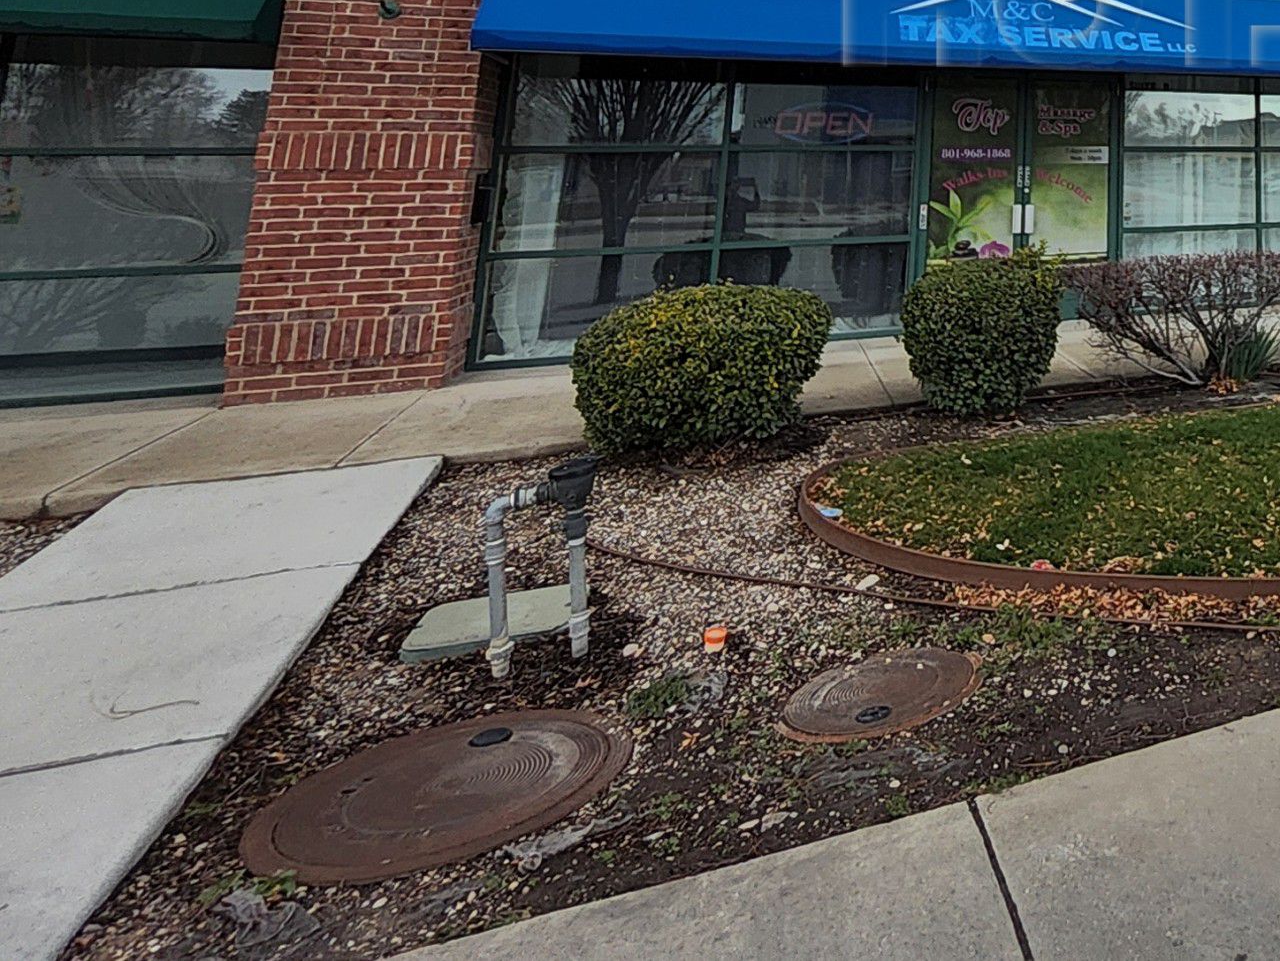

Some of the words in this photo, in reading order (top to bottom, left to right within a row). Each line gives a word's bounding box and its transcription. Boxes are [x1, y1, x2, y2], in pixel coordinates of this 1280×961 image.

[900, 15, 985, 45] TAX
[997, 23, 1165, 53] SERVICE
[1167, 42, 1198, 54] LLC
[774, 111, 873, 136] OPEN
[951, 98, 1010, 136] Top
[1038, 104, 1096, 123] Massage
[1038, 119, 1052, 135] &
[1053, 119, 1081, 138] Spa
[941, 148, 1011, 159] 801-968-1868
